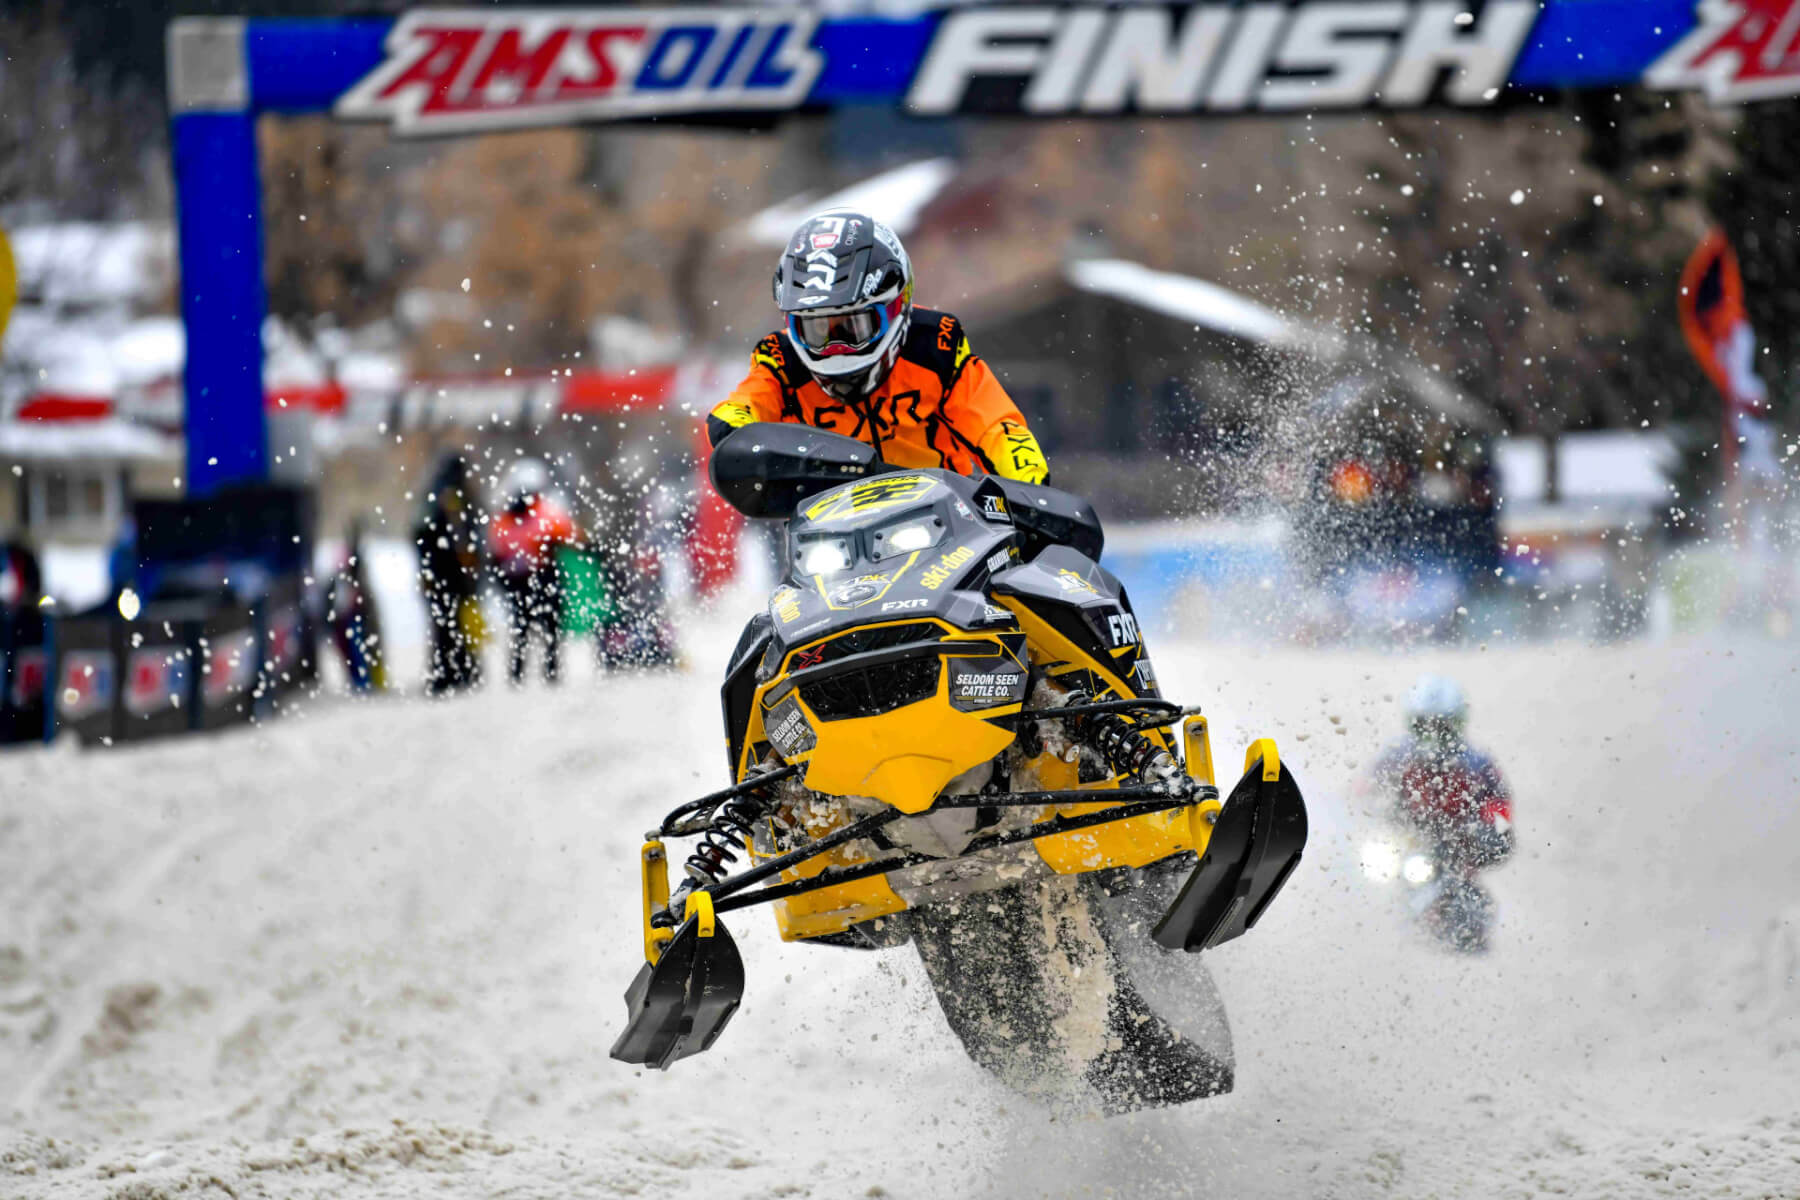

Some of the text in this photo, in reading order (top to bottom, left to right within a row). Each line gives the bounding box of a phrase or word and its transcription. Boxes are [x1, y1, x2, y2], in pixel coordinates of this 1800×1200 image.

[377, 23, 798, 117] AMSOIL
[904, 2, 1540, 113] FINISH
[937, 315, 955, 351] FXR
[920, 545, 976, 590] ski-doo
[881, 598, 929, 612] FXR
[955, 673, 1019, 686] SELDOM SEEN
[961, 685, 1010, 697] CATTLE CO.
